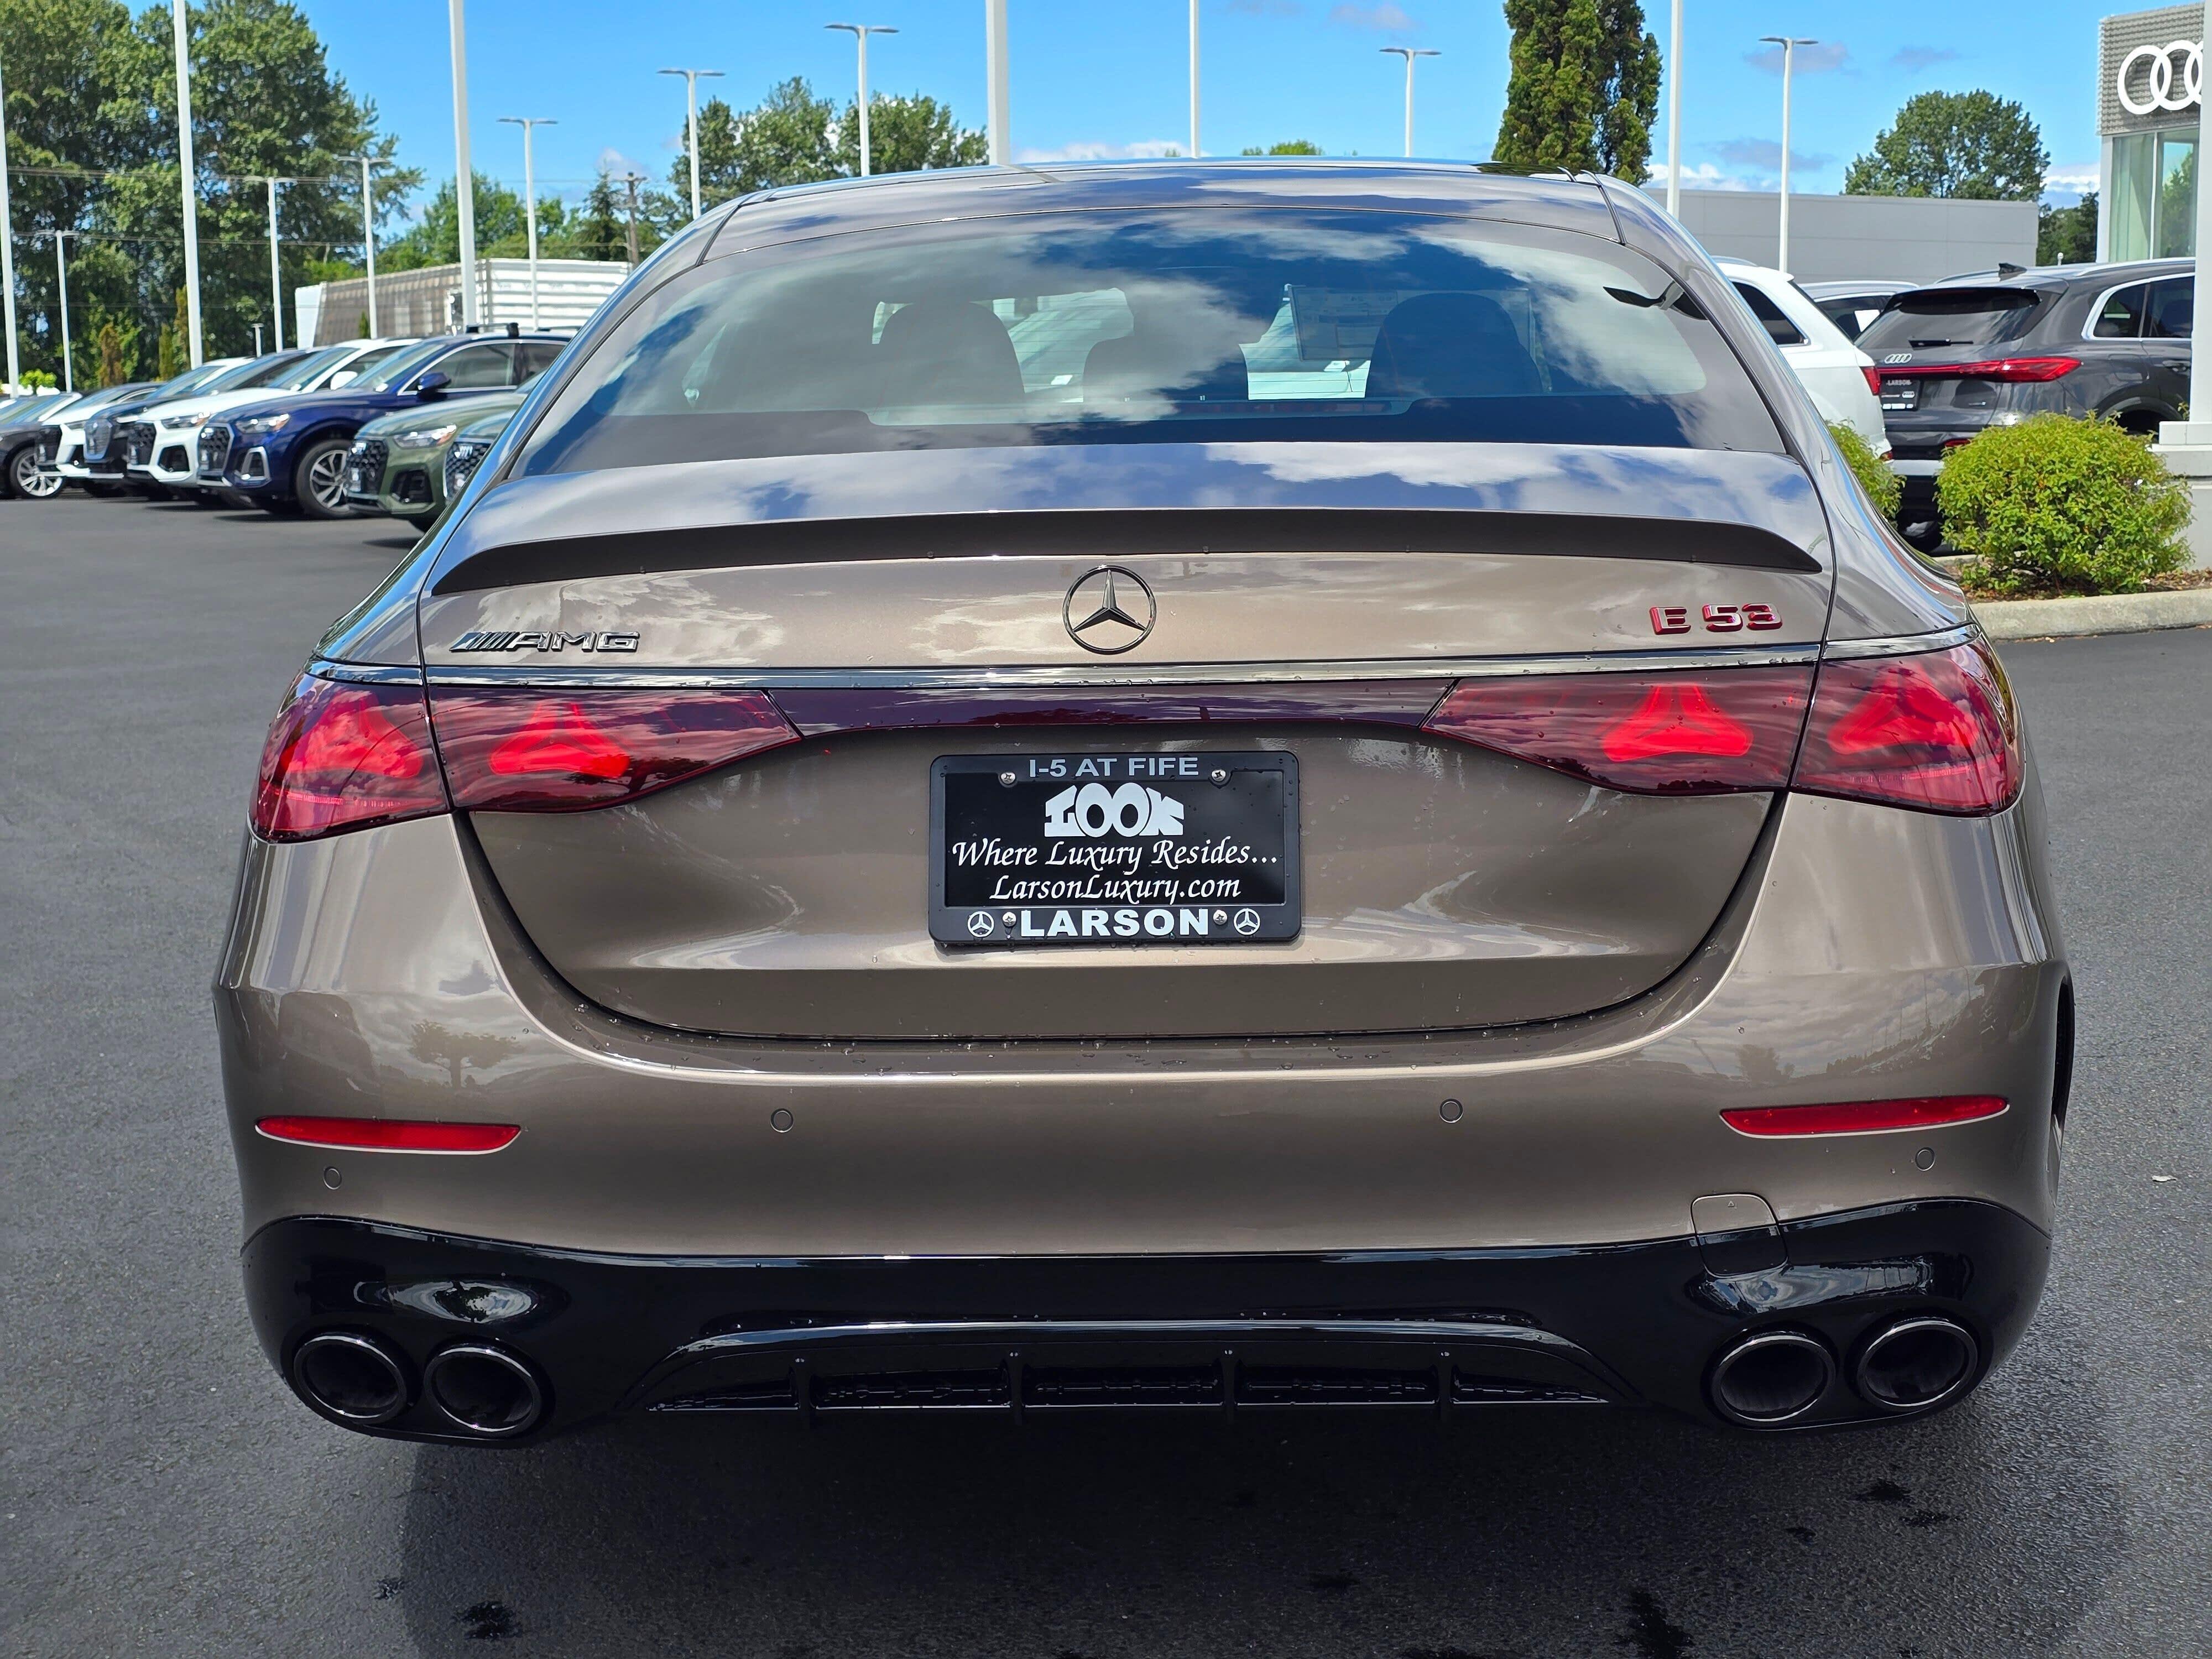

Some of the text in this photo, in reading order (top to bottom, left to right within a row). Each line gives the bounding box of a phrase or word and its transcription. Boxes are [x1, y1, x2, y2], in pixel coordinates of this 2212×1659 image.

[1649, 602, 1783, 635] E 53
[505, 630, 640, 653] AMG
[1029, 757, 1199, 778] I-5 AT FIFE
[952, 835, 1278, 875] Where Luxury Resides...
[989, 874, 1241, 905] LarsonLuxury.com
[1020, 909, 1209, 937] LARSON
